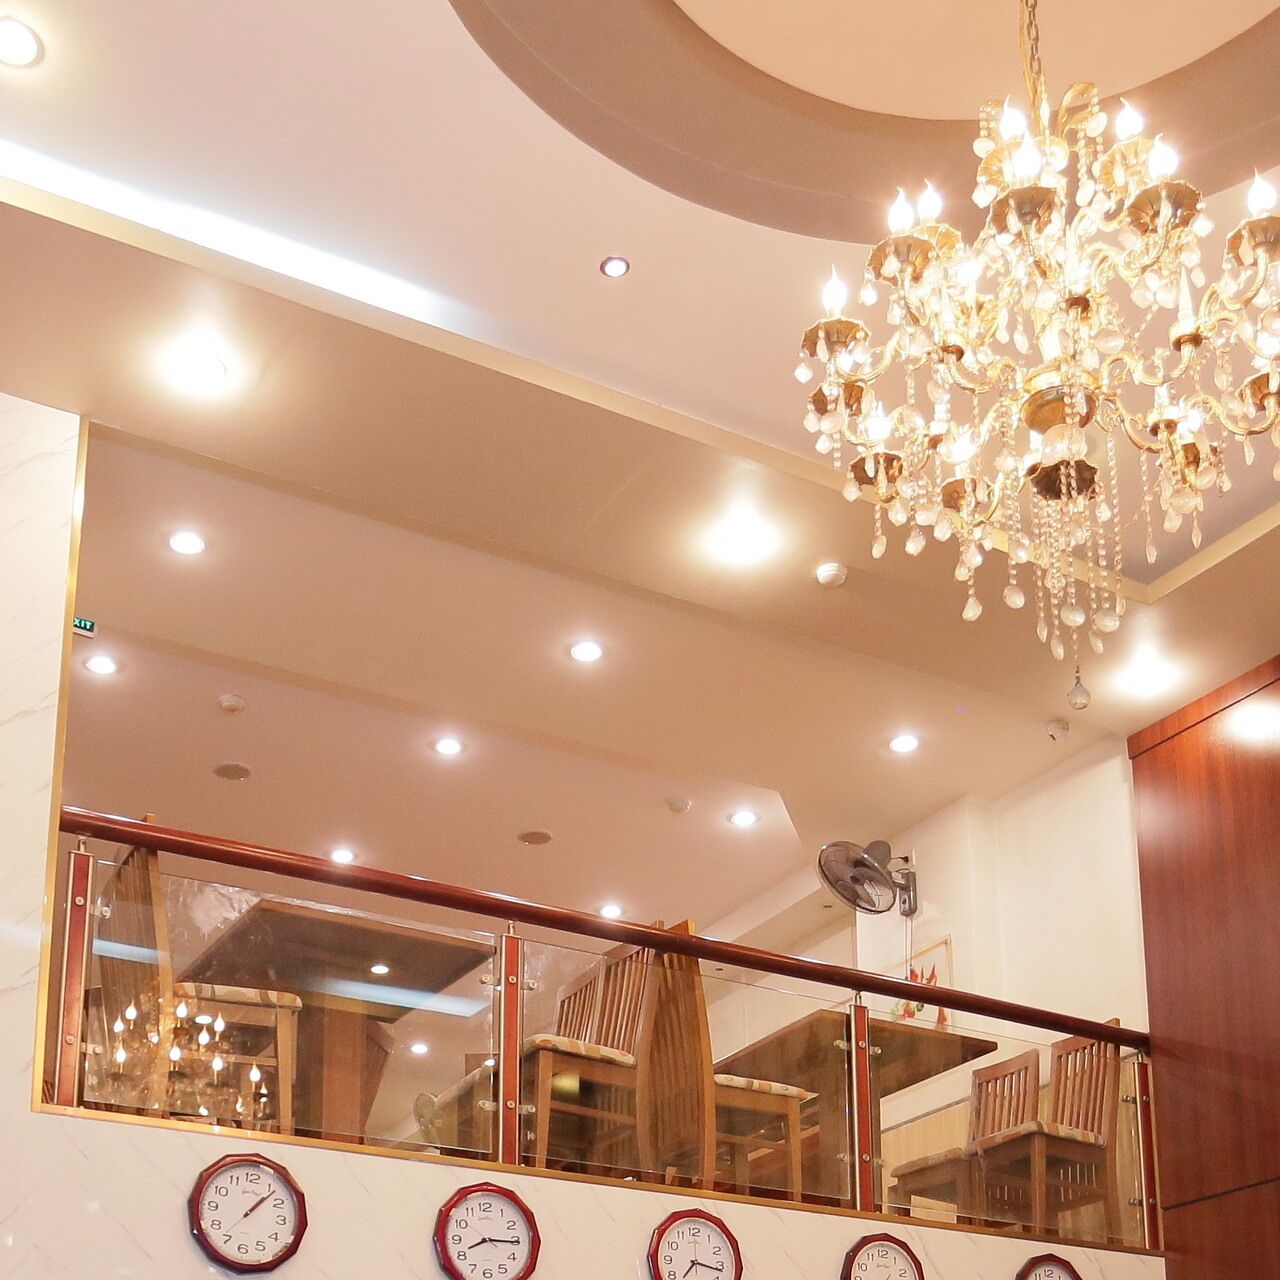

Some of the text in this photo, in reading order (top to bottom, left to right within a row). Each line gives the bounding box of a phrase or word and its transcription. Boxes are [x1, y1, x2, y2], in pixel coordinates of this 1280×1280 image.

[73, 617, 93, 630] XIT
[230, 1175, 239, 1185] 11
[246, 1172, 260, 1184] 12
[215, 1186, 228, 1197] 10
[208, 1201, 218, 1211] 9
[273, 1199, 284, 1209] 2
[479, 1202, 492, 1212] 12
[466, 1207, 474, 1216] 11
[210, 1220, 221, 1230] 8
[275, 1215, 286, 1225] 3
[456, 1219, 468, 1229] 10
[507, 1220, 516, 1230] 2
[268, 1232, 279, 1242] 4
[677, 1231, 684, 1240] 11
[689, 1228, 700, 1237] 12
[222, 1234, 232, 1244] 7
[452, 1235, 461, 1244] 9
[238, 1244, 248, 1254] 6
[255, 1241, 266, 1251] 5
[668, 1241, 678, 1250] 10
[713, 1246, 721, 1255] 2
[457, 1251, 467, 1260] 8
[507, 1253, 517, 1261] 4
[867, 1253, 874, 1261] 11
[878, 1249, 888, 1259] 12
[664, 1255, 672, 1264] 9
[469, 1264, 477, 1274] 7
[498, 1264, 507, 1274] 5
[716, 1261, 724, 1270] 3
[858, 1263, 867, 1271] 10
[483, 1269, 492, 1278] 6
[668, 1271, 676, 1280] 8
[899, 1269, 906, 1277] 2
[1035, 1273, 1040, 1280] 11
[1044, 1269, 1053, 1278] 12
